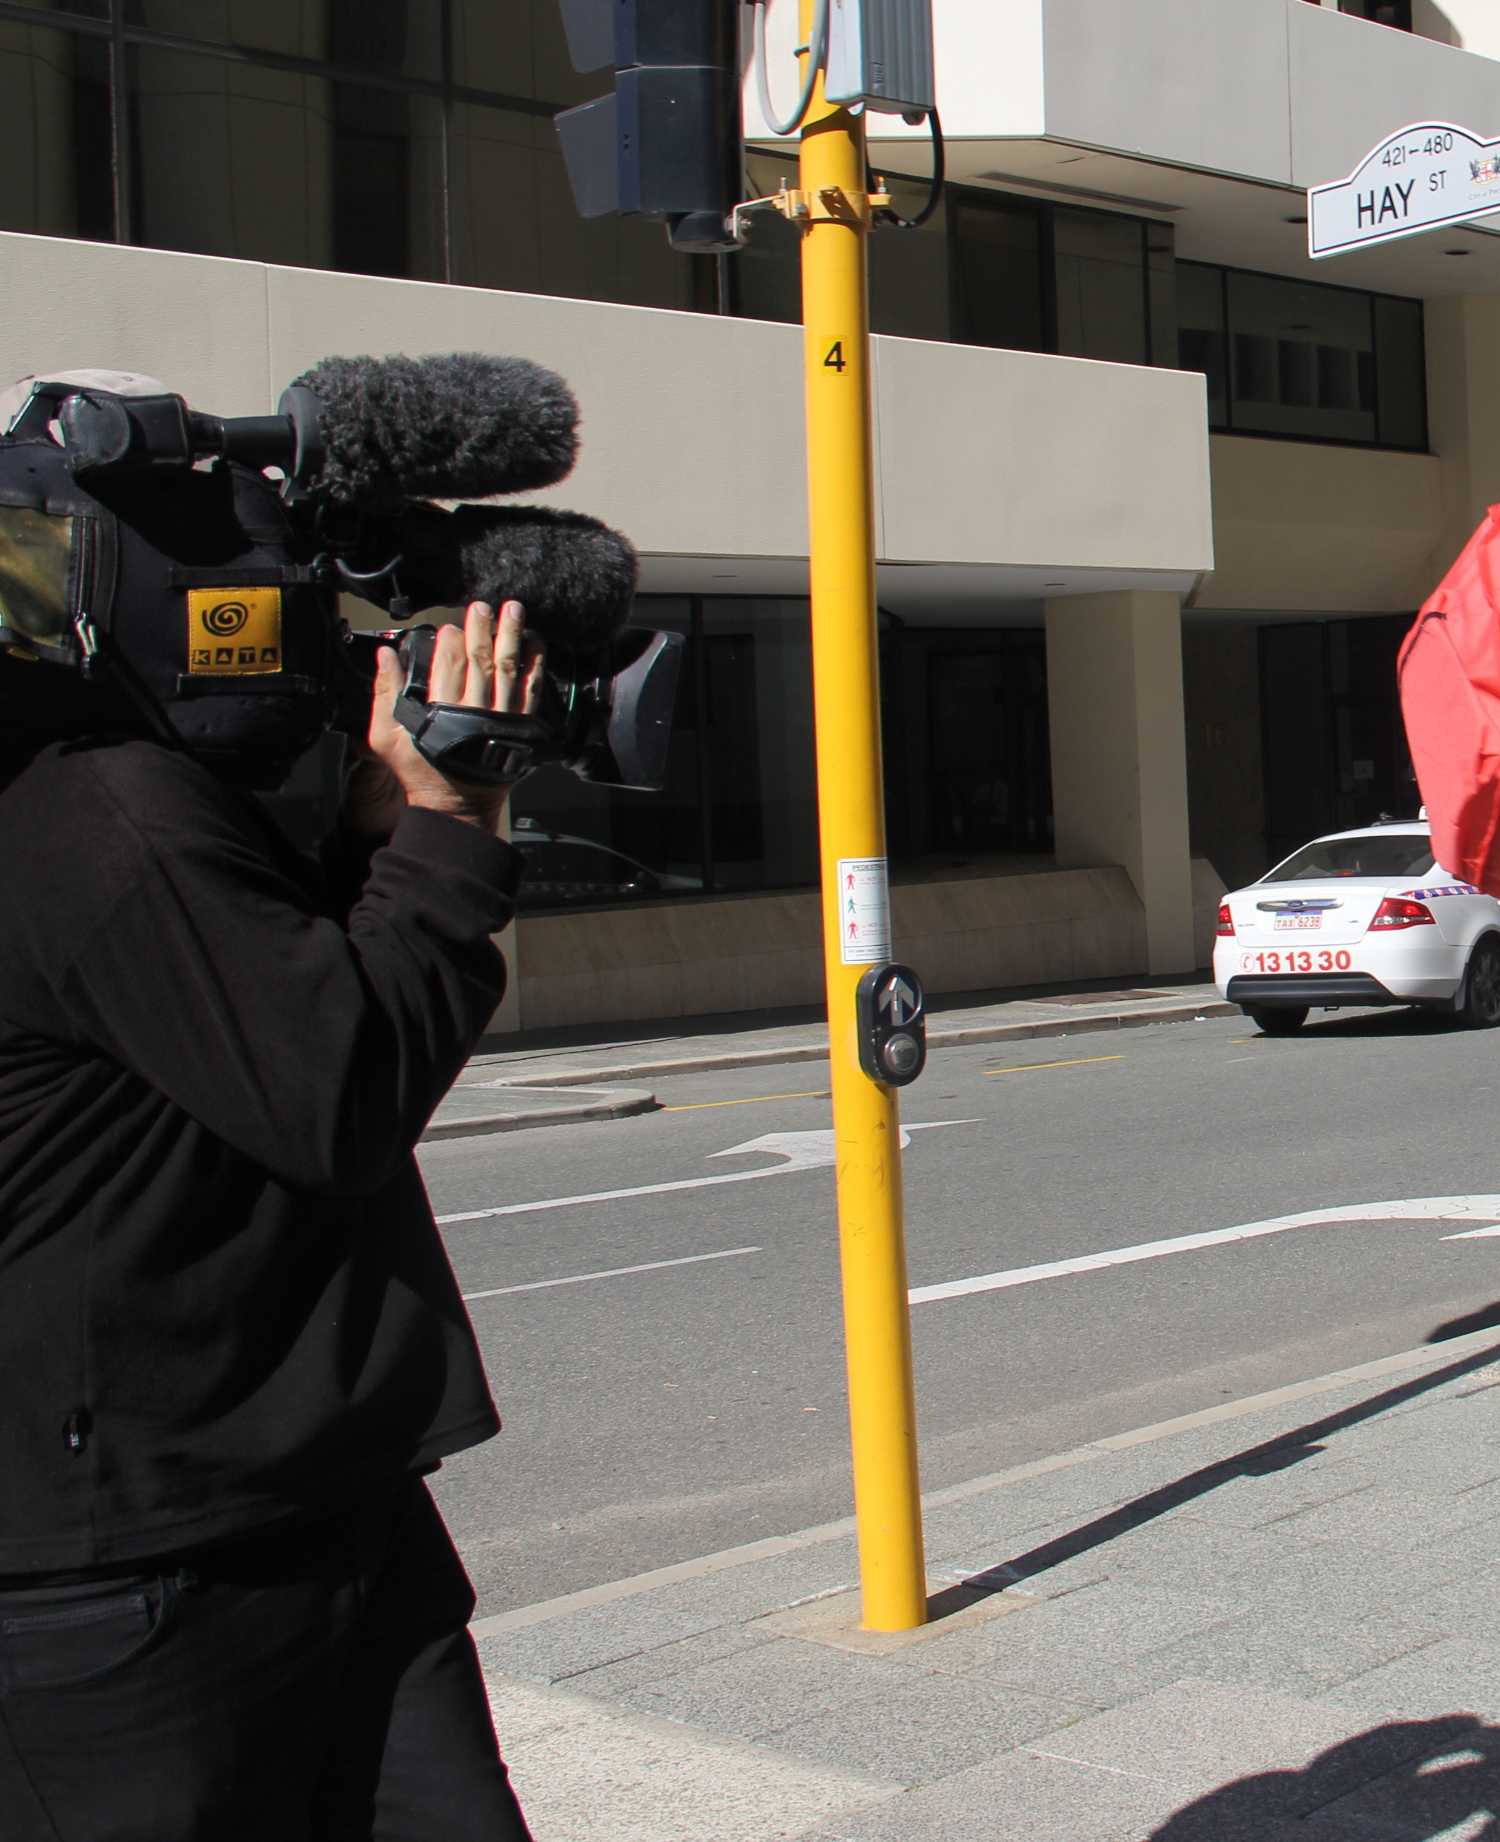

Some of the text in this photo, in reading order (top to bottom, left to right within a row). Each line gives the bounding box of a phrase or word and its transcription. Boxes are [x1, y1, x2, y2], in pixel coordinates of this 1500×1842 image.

[1382, 133, 1453, 167] 421-480
[1357, 170, 1447, 229] HAY ST
[823, 341, 847, 373] 4
[192, 647, 279, 665] KATA
[1256, 949, 1352, 973] 13 13 30
